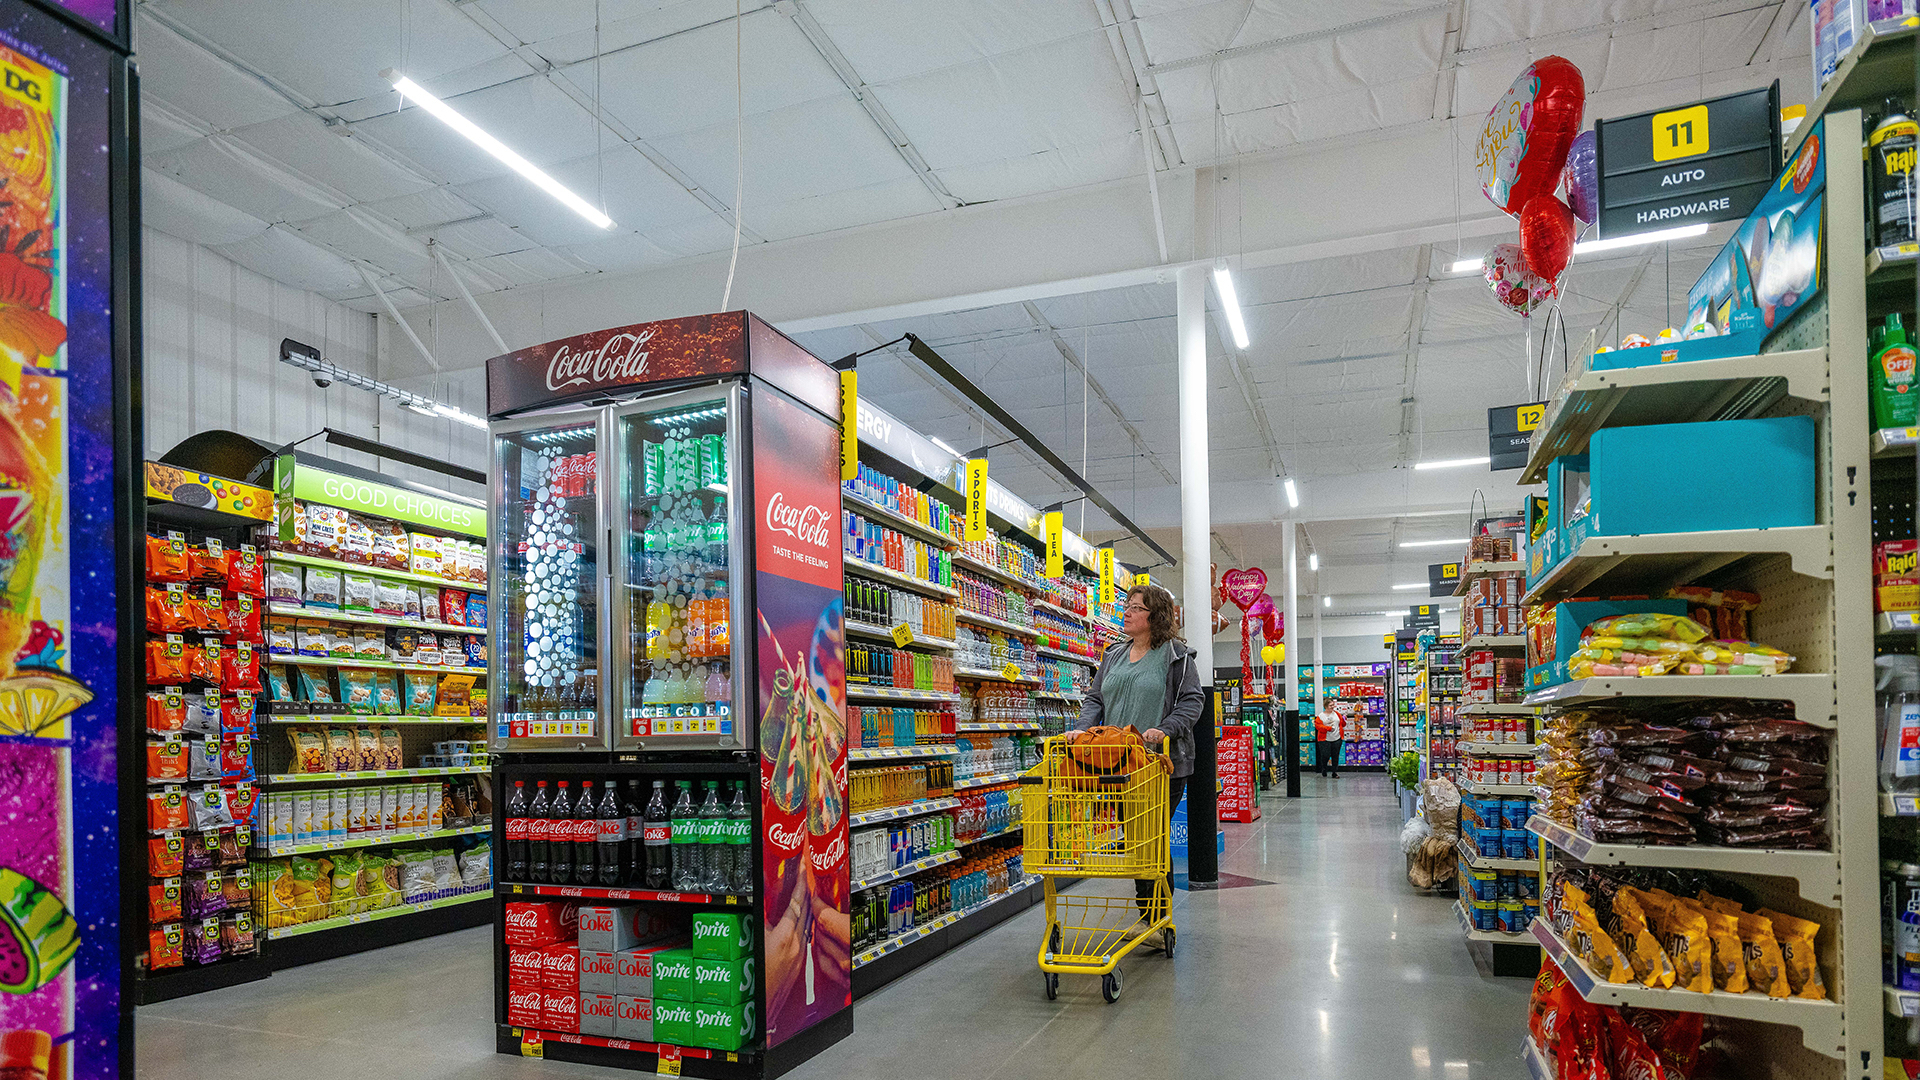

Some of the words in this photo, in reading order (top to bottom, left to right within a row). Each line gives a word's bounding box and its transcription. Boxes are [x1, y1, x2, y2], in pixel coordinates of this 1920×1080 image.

[4, 67, 41, 103] DG
[1666, 122, 1694, 148] 11
[1661, 169, 1705, 187] AUTO
[1637, 197, 1730, 224] HARDWARE
[545, 330, 656, 391] Coca-Cola
[1886, 359, 1913, 370] OFF!
[857, 406, 892, 444] ERGY
[1522, 411, 1541, 425] 12
[1510, 437, 1530, 446] SEAS
[323, 478, 388, 508] GOOD
[393, 494, 472, 527] CHOICES
[972, 469, 980, 531] SPORTS
[766, 492, 832, 548] Coca-Cola
[772, 545, 791, 559] TASTE
[792, 551, 804, 563] THE
[805, 555, 829, 569] FEELING
[1887, 552, 1917, 577] Raid
[1232, 573, 1259, 583] Happy
[1445, 567, 1455, 575] 14
[1237, 589, 1254, 601] Day
[546, 711, 596, 721] COLD
[676, 706, 729, 718] COLD
[161, 757, 178, 765] THINS
[671, 821, 699, 837] prite
[699, 821, 727, 837] prite
[727, 821, 752, 836] rite
[768, 818, 807, 851] Coca-Co
[579, 914, 613, 932] Coke
[694, 920, 730, 939] Sprite
[581, 956, 614, 974] Coke
[618, 959, 652, 977] Coke
[655, 962, 691, 980] Sprite
[695, 965, 731, 984] Sprite
[581, 998, 614, 1017] Coke
[617, 1001, 652, 1021] Coke
[656, 1006, 691, 1024] Sprite
[695, 1009, 732, 1028] Sprite
[668, 1065, 680, 1074] FREE
